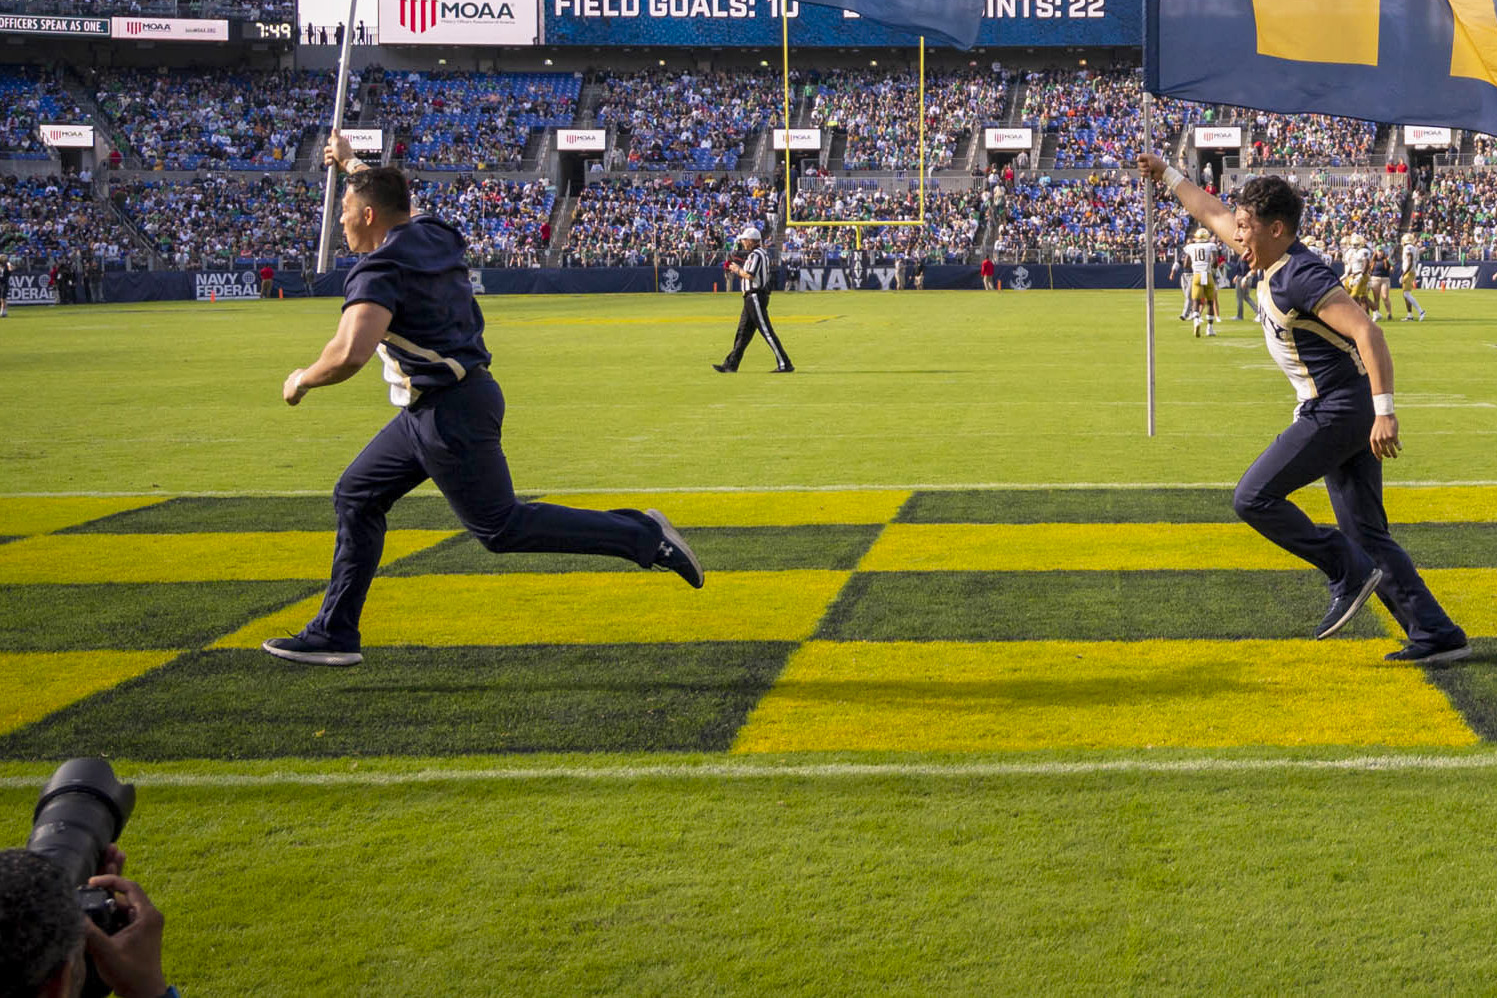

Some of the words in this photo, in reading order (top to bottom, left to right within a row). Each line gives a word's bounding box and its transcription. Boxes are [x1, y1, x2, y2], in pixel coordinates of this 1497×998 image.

[441, 2, 514, 19] MOAA
[0, 17, 38, 30] OFFICERS
[40, 18, 69, 31] SPEAK
[70, 20, 82, 31] AS
[83, 21, 104, 32] ONE.
[142, 23, 171, 31] MOAA
[256, 23, 291, 39] 7:49
[1194, 248, 1206, 262] 10
[854, 251, 863, 288] NAVY
[8, 275, 35, 288] AVY
[196, 273, 240, 286] NAVY
[1422, 277, 1476, 290] Mutual
[196, 285, 261, 298] FEDERAL
